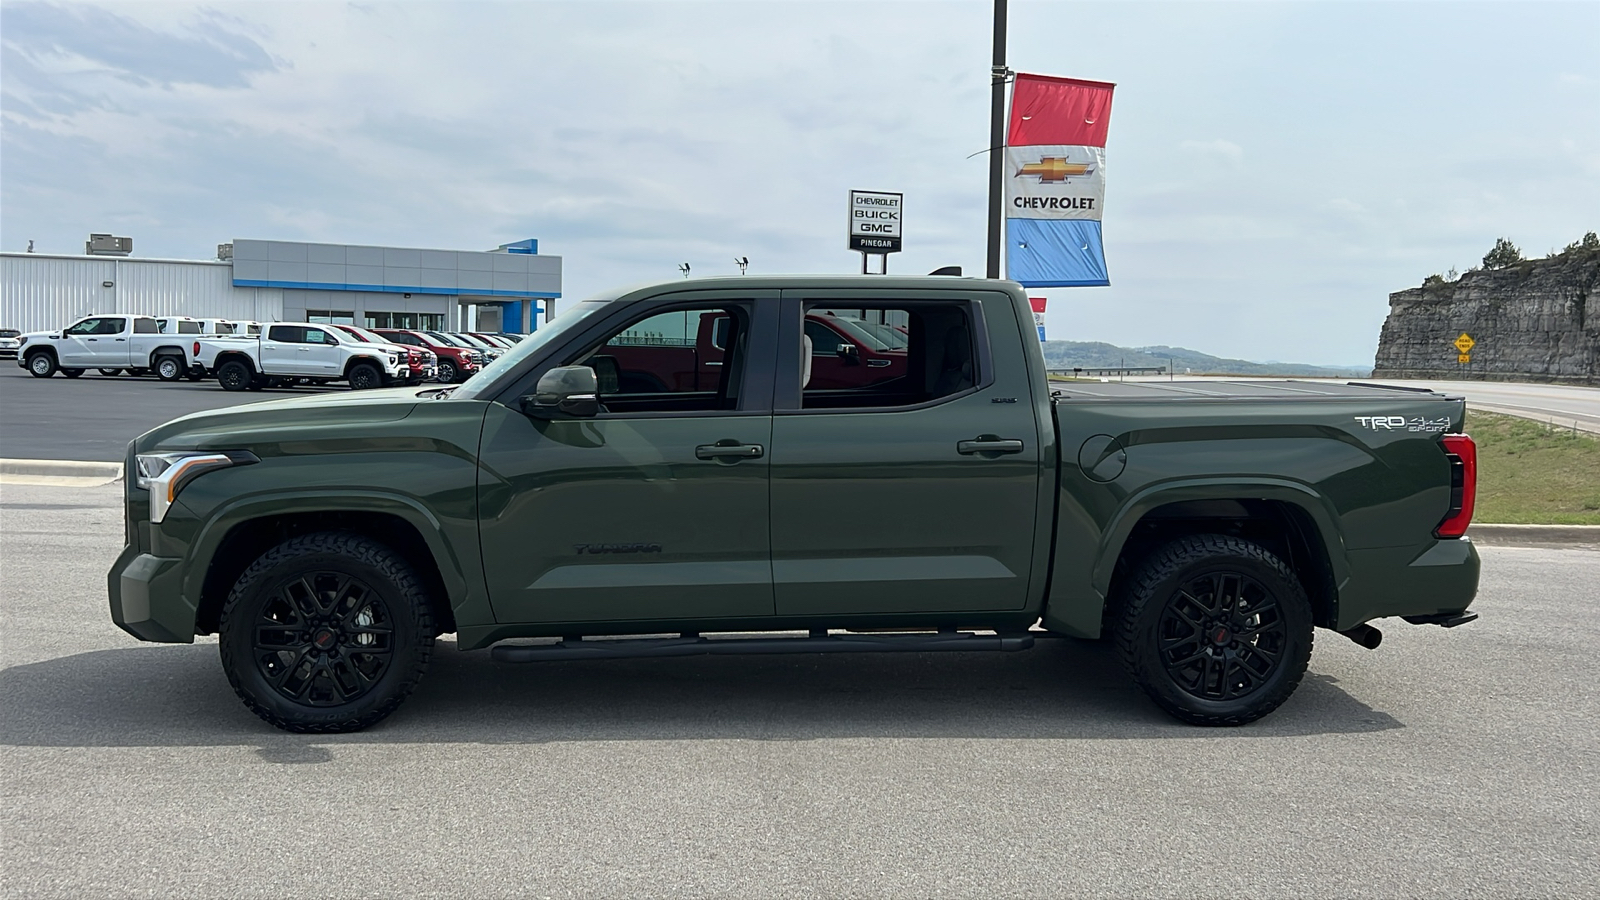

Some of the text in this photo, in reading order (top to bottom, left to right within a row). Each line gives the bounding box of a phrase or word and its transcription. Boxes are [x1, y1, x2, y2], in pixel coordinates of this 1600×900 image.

[856, 197, 898, 206] CHEVROLET
[1013, 196, 1095, 210] CHEVROLET
[855, 209, 898, 220] BUICK
[860, 223, 893, 233] GMC
[860, 239, 892, 248] PINEGAR
[1354, 416, 1407, 431] TRD
[573, 543, 662, 555] TUNDRA
